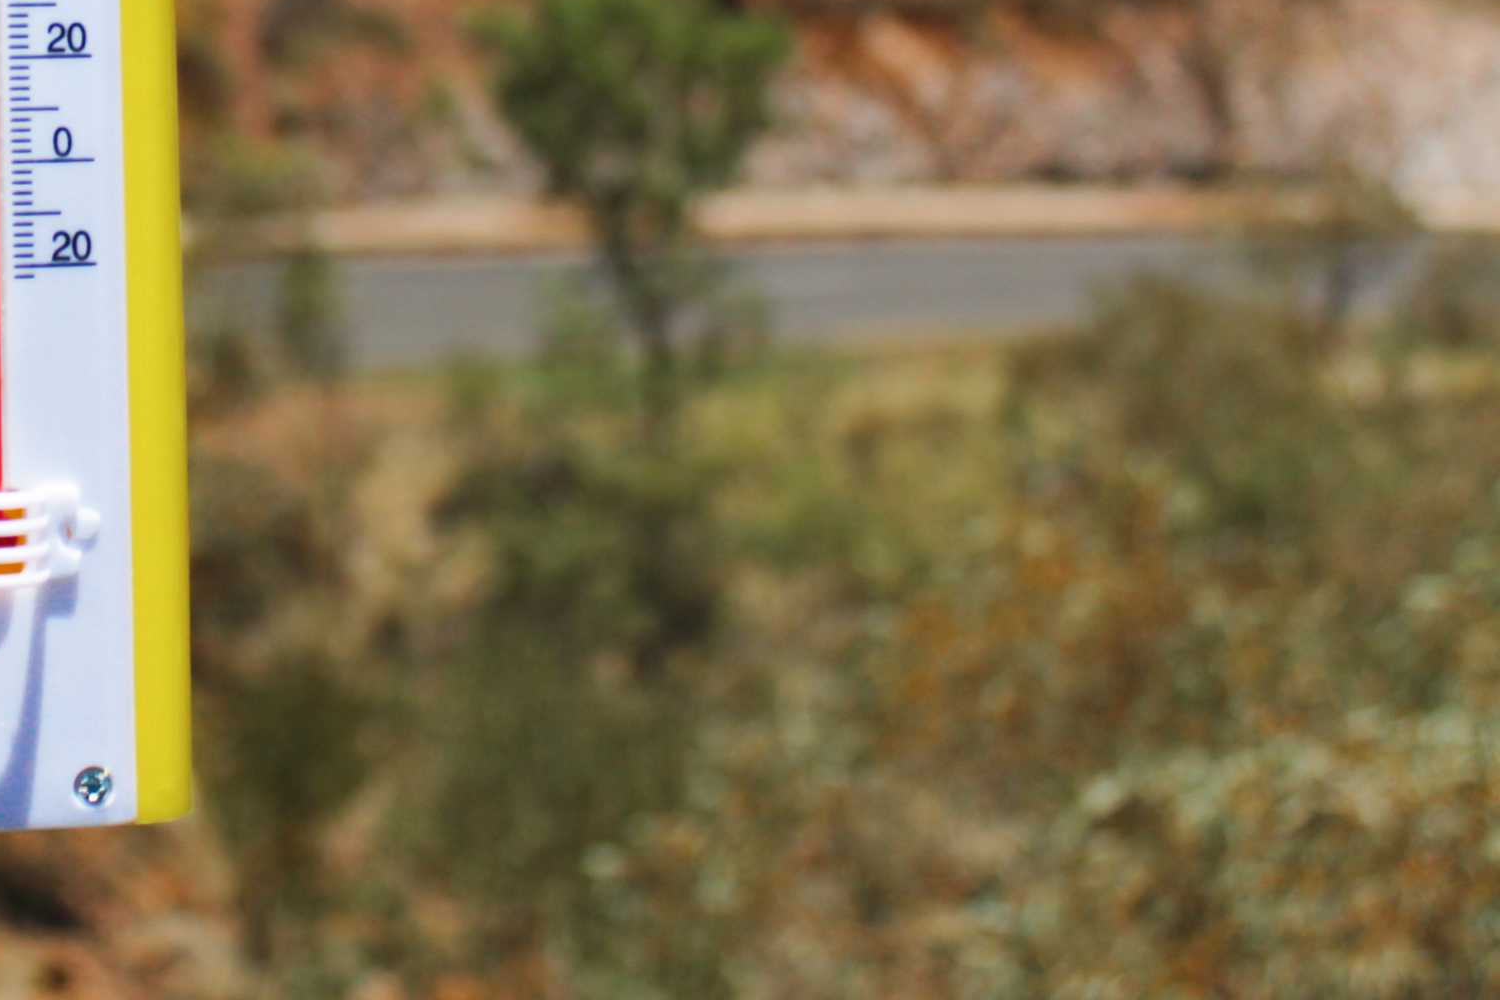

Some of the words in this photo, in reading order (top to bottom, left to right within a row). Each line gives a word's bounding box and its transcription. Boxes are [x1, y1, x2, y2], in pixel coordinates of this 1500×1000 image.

[47, 22, 86, 53] 20
[53, 127, 73, 157] 0
[51, 230, 91, 261] 20
